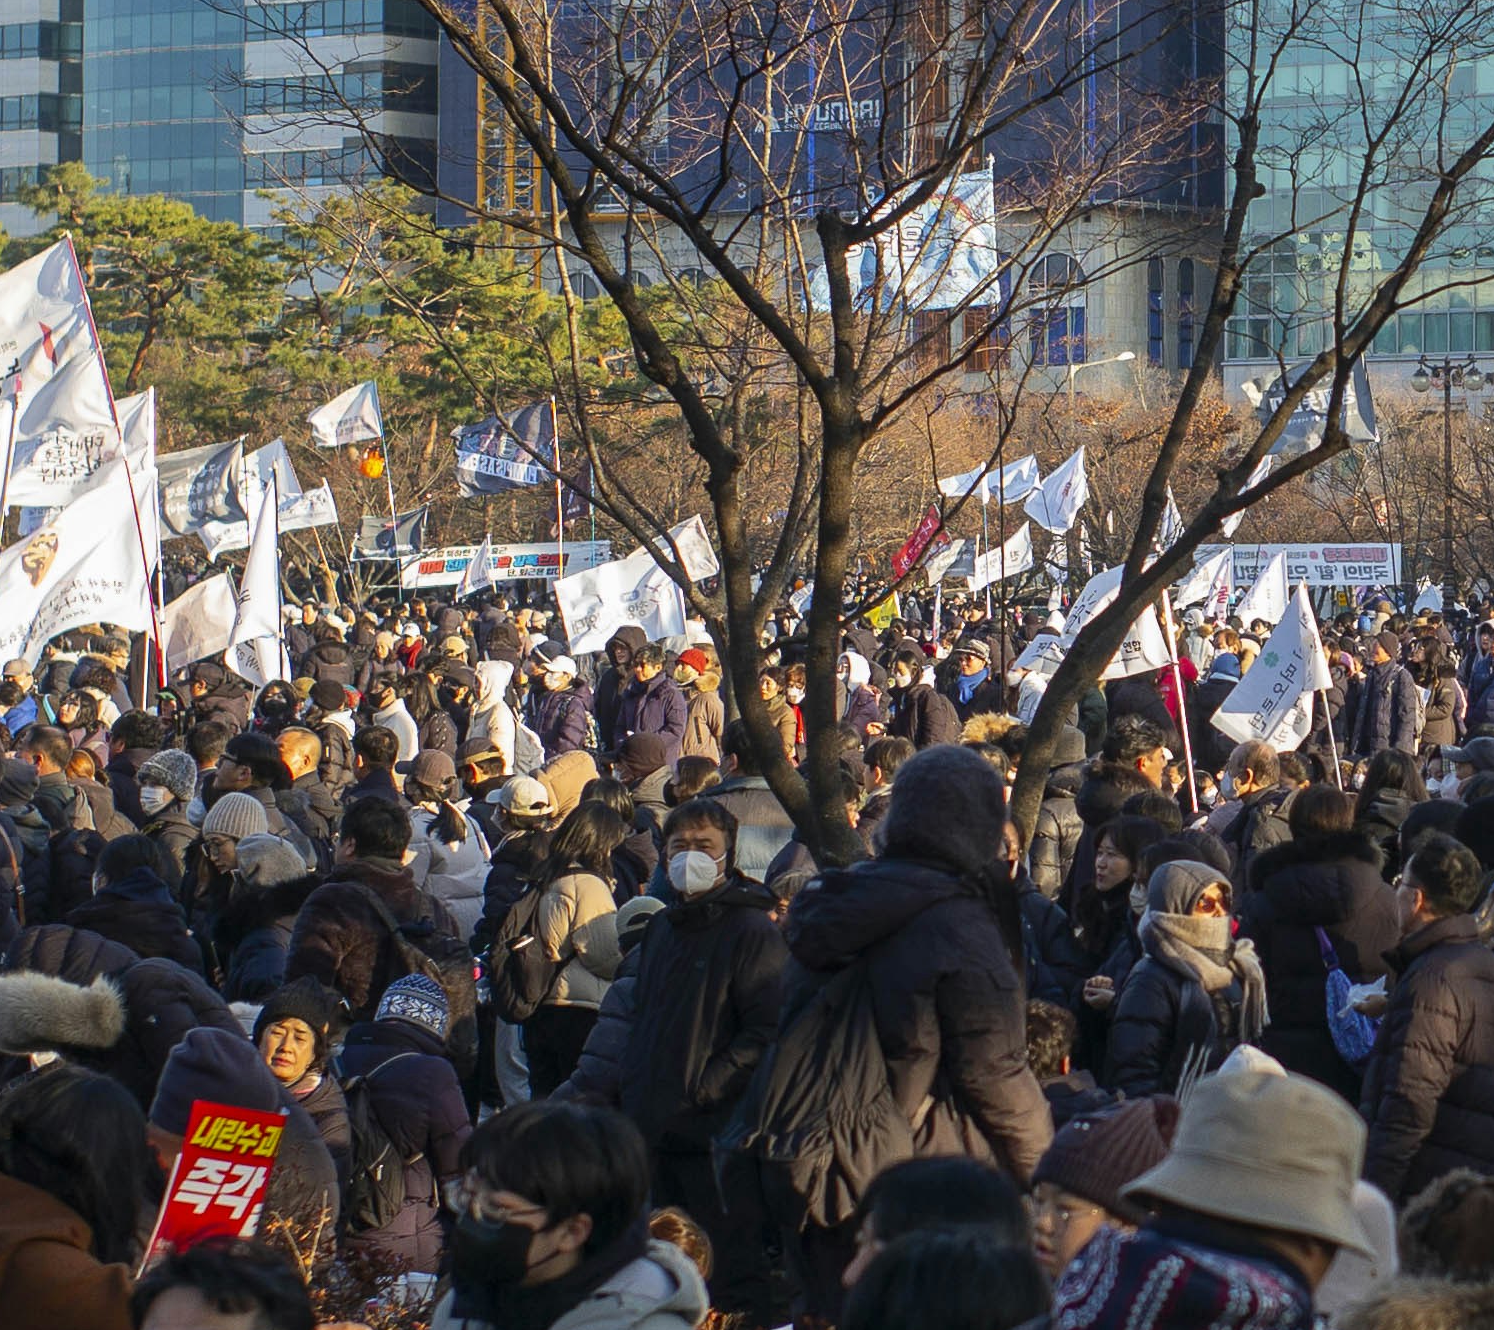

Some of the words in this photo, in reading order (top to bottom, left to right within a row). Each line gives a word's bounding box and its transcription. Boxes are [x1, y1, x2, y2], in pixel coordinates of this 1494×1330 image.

[1122, 639, 1142, 654] 연합
[189, 1115, 284, 1158] 내란수괴
[172, 1156, 268, 1221] 즉각
